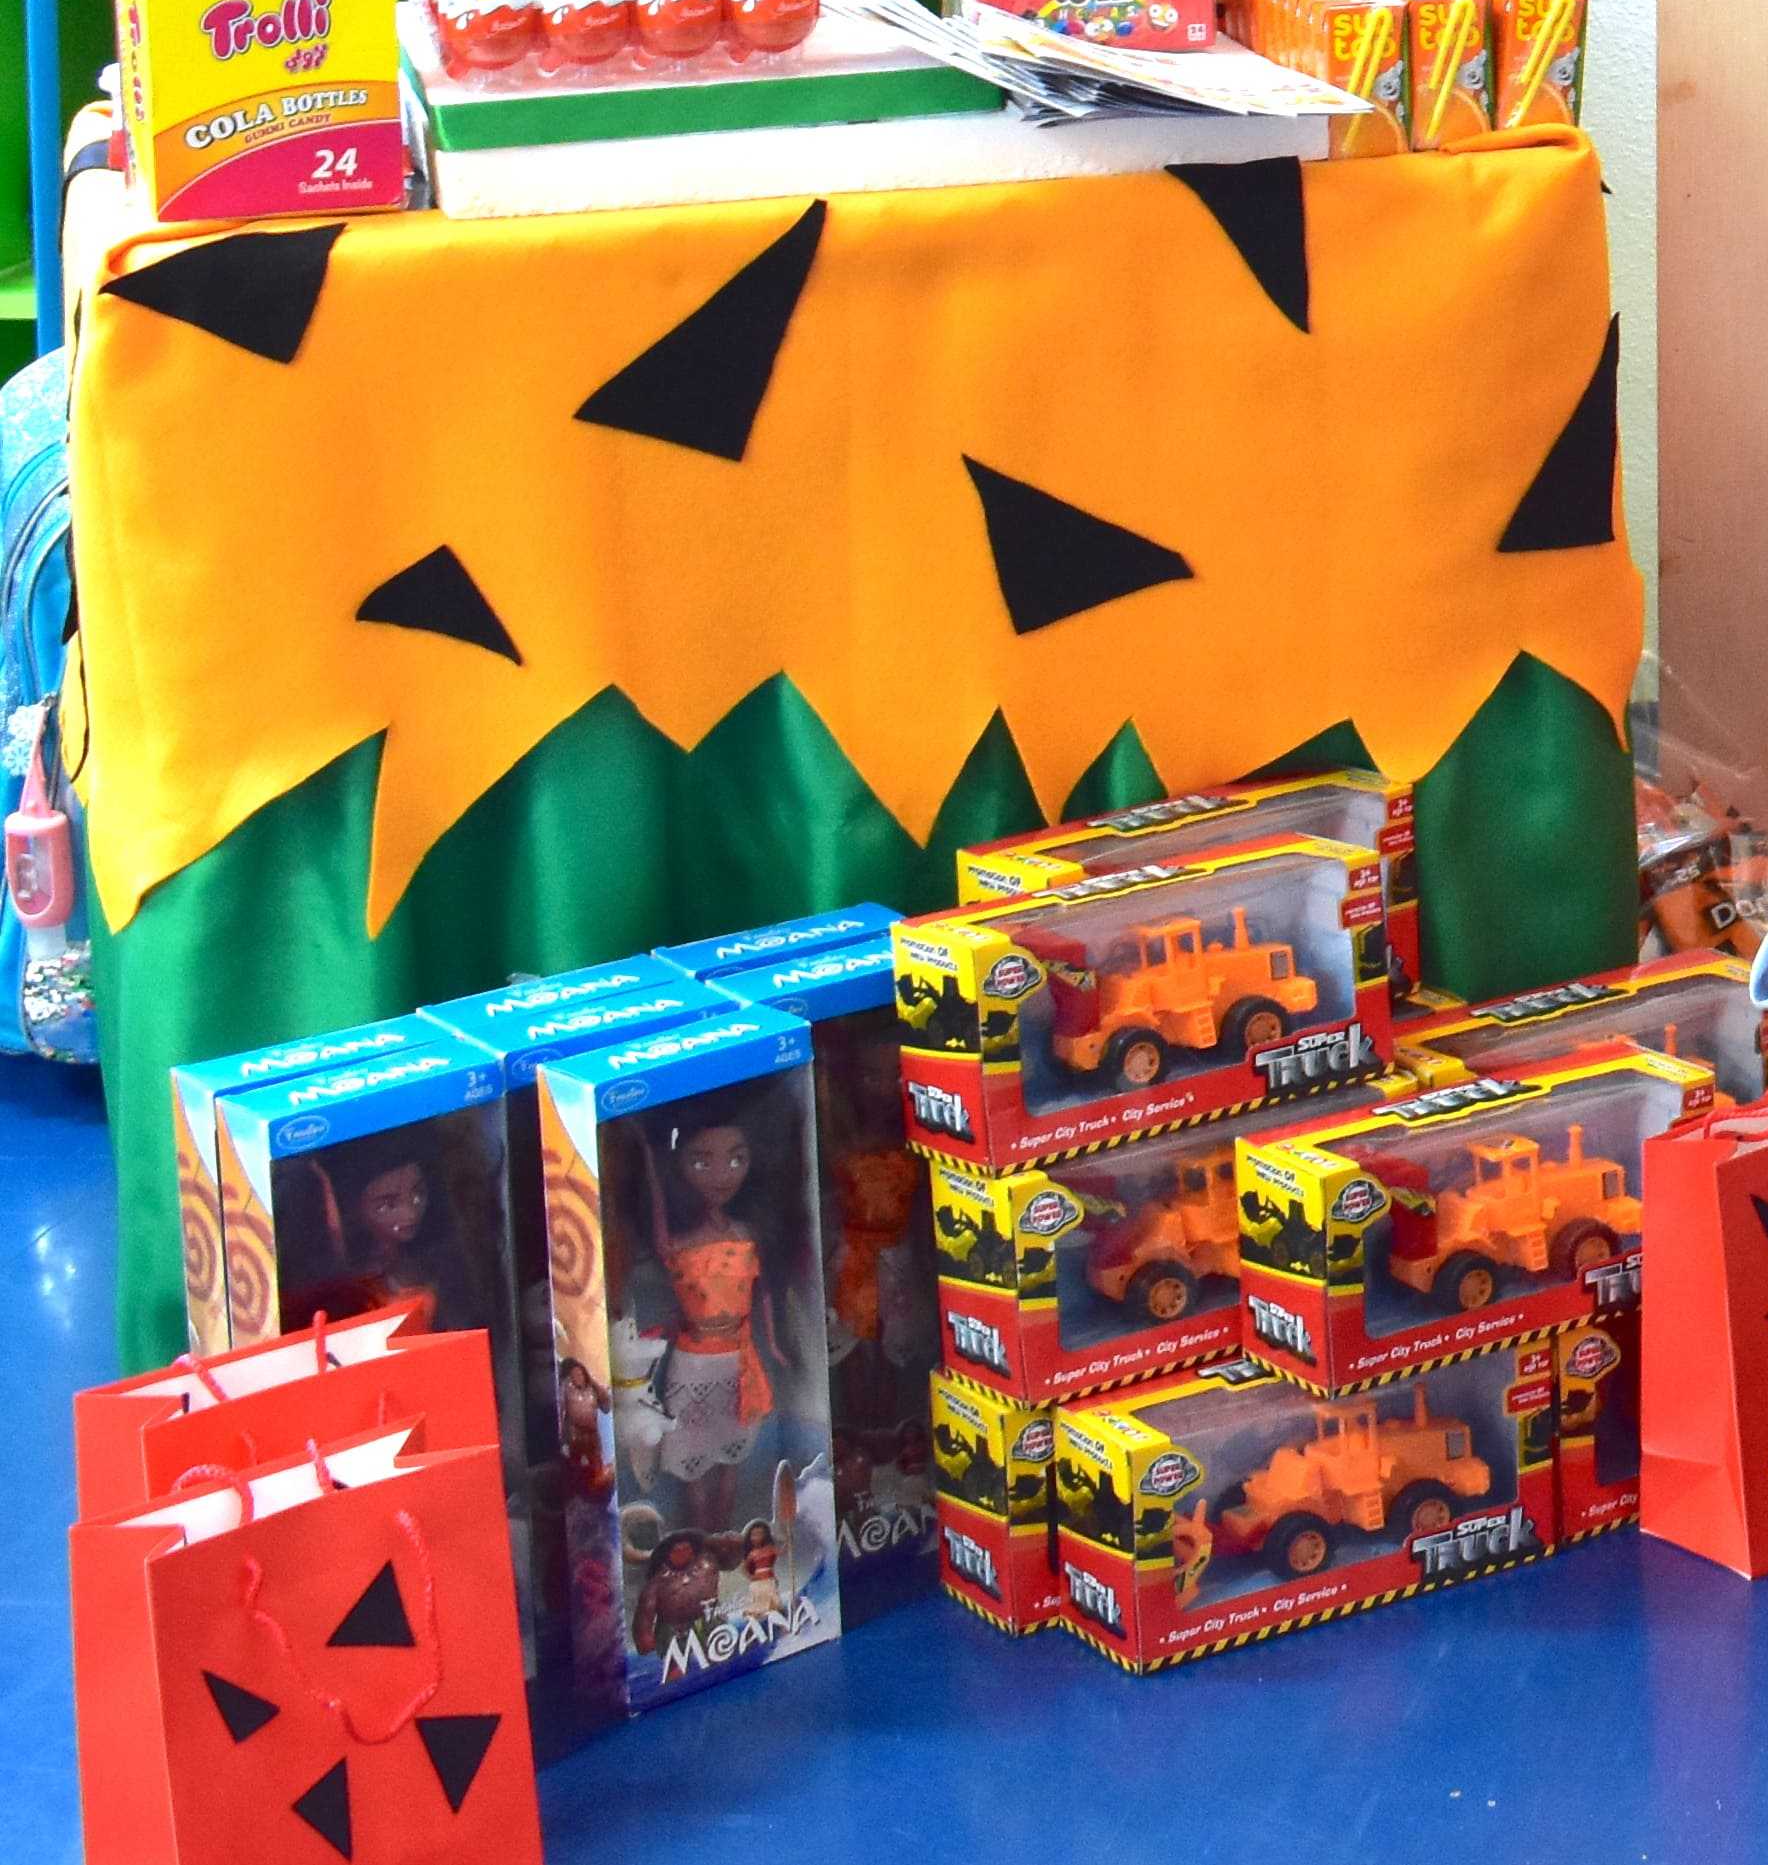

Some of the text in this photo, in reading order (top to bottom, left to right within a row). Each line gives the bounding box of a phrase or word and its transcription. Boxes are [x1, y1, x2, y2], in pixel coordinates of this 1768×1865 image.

[184, 89, 369, 149] COLA BOTTLES
[288, 112, 332, 130] CANDY
[311, 147, 359, 179] 24
[715, 919, 866, 959] MOANA
[772, 950, 894, 988] MOAN
[486, 974, 641, 1017] MOANA
[527, 997, 686, 1041] MOANA
[241, 1033, 406, 1076] MOANA
[608, 1022, 762, 1070] MOANA
[777, 1035, 797, 1051] 3+
[1297, 1031, 1346, 1051] SUPER
[289, 1056, 452, 1106] MOANA
[467, 1070, 488, 1087] 3+
[1019, 1097, 1187, 1151] Super City Truck City Service
[1054, 1329, 1221, 1385] Super City Truck City Service
[1356, 1313, 1517, 1371] Super City Truck City Service
[1456, 1514, 1507, 1537] SUPER
[1588, 1492, 1639, 1518] Super City
[838, 1503, 938, 1560] OAN
[1168, 1586, 1338, 1644] Super City Truck City Service
[661, 1595, 822, 1685] MOANA
